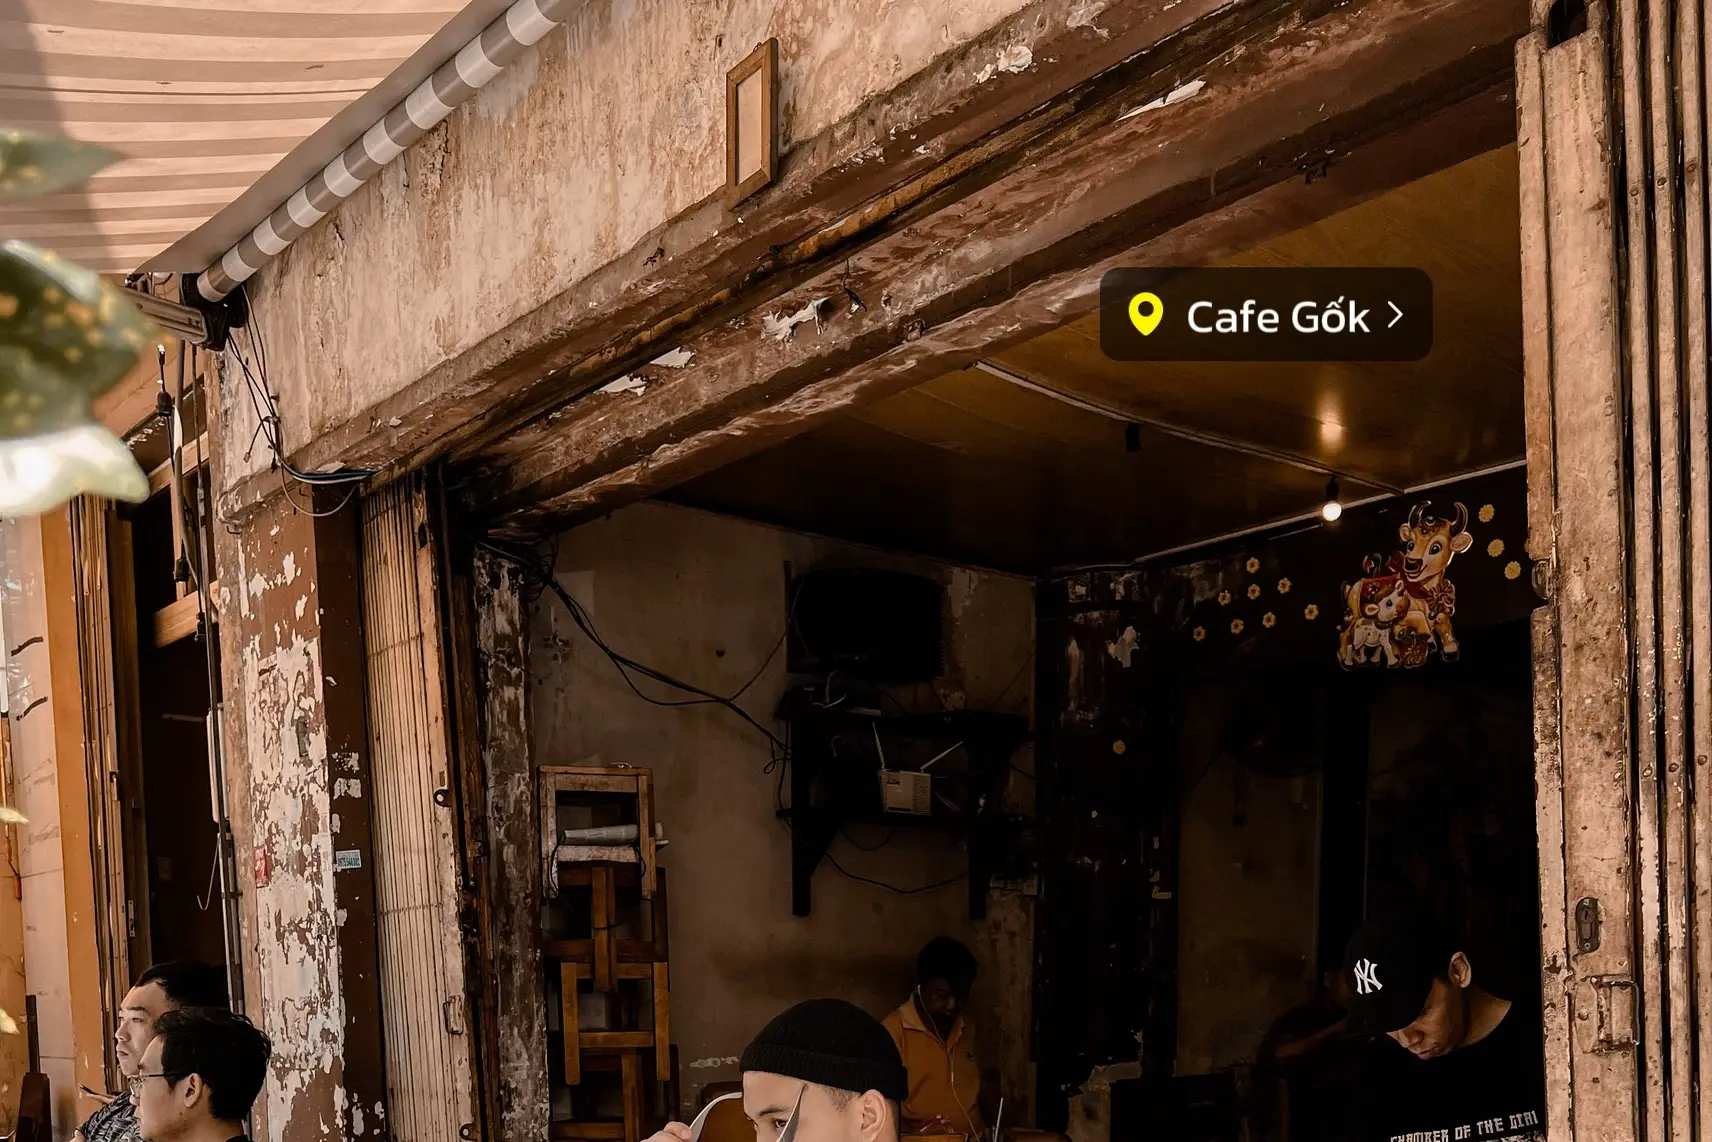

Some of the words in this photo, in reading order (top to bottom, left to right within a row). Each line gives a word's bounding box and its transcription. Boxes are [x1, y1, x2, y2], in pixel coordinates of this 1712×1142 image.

[1353, 958, 1383, 995] NY
[1454, 1124, 1471, 1141] OF
[1476, 1117, 1504, 1135] THE
